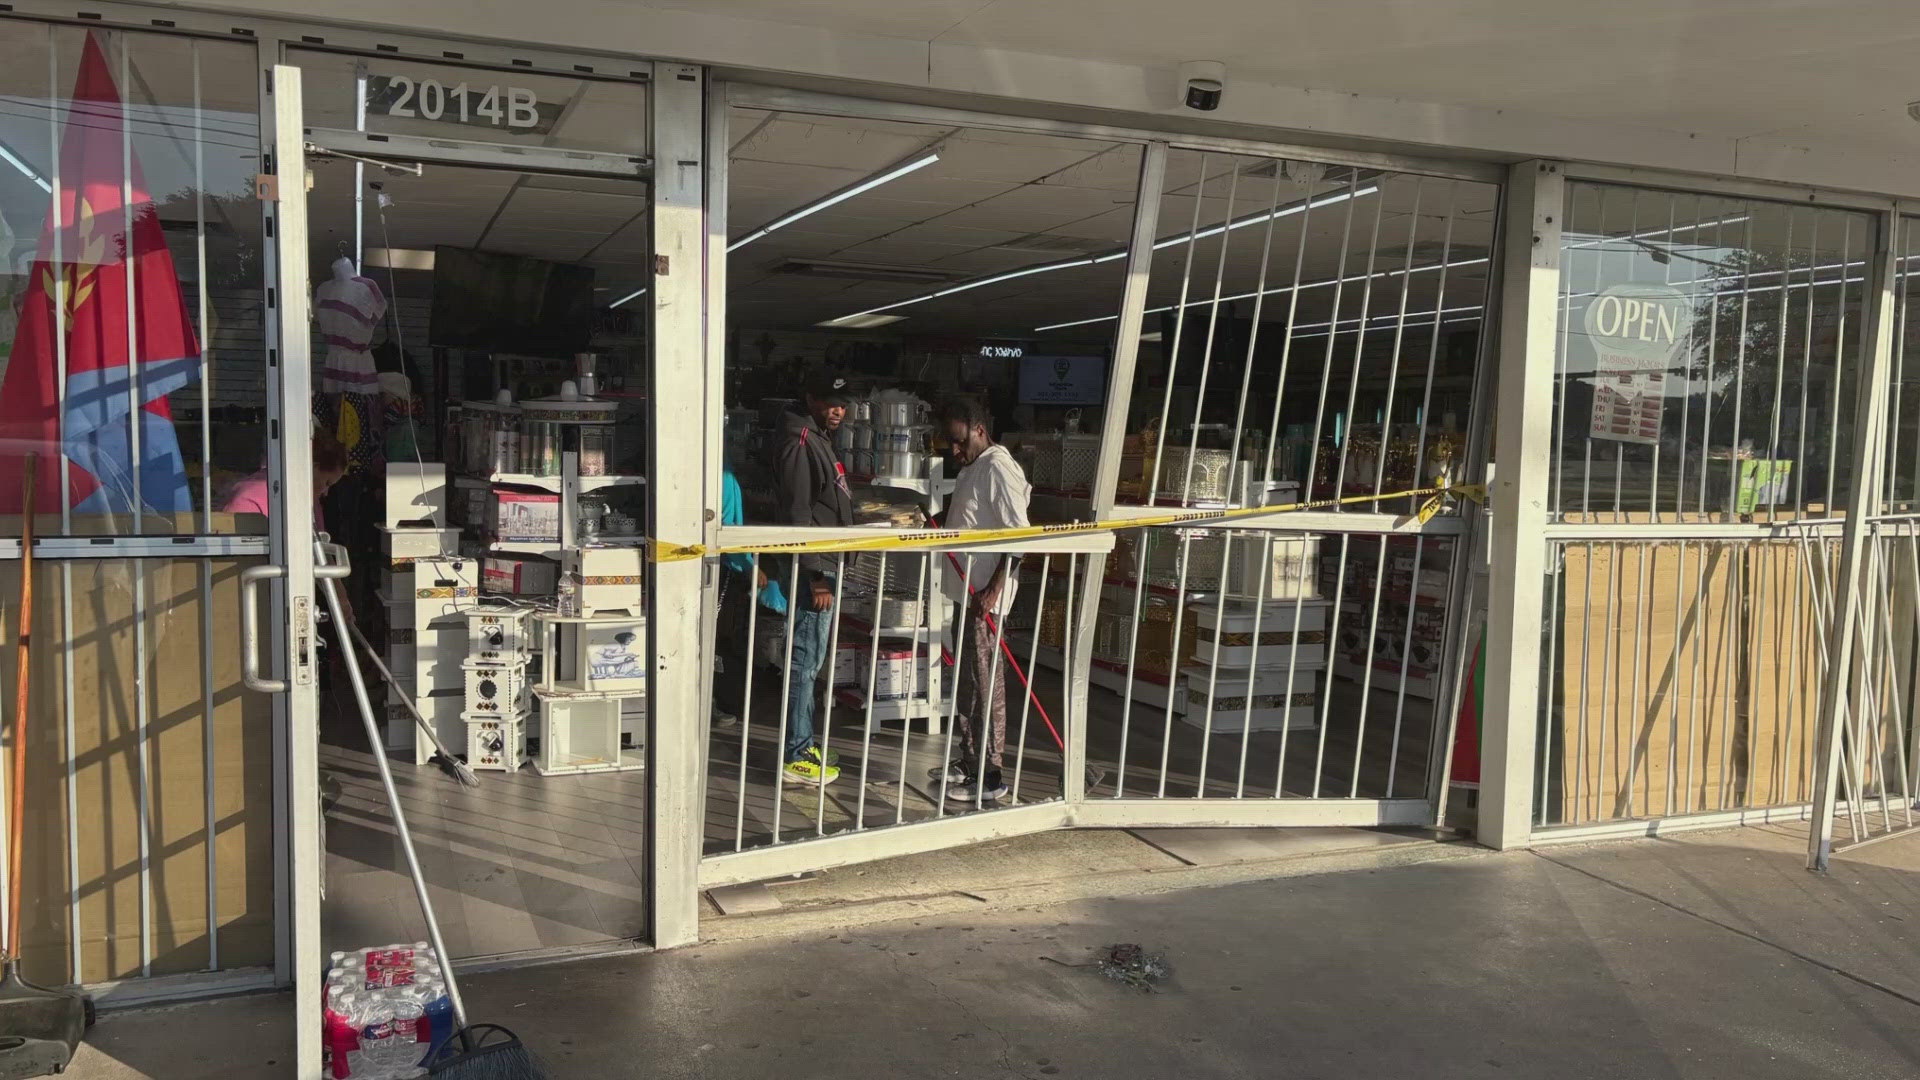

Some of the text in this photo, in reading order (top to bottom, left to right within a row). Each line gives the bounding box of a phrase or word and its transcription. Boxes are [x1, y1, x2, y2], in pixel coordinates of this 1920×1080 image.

[388, 76, 539, 128] 2014B
[1596, 296, 1678, 344] OPEN
[1597, 395, 1611, 404] THU
[1595, 405, 1606, 413] FRI
[1594, 415, 1605, 423] SAT
[1593, 424, 1606, 433] SUN
